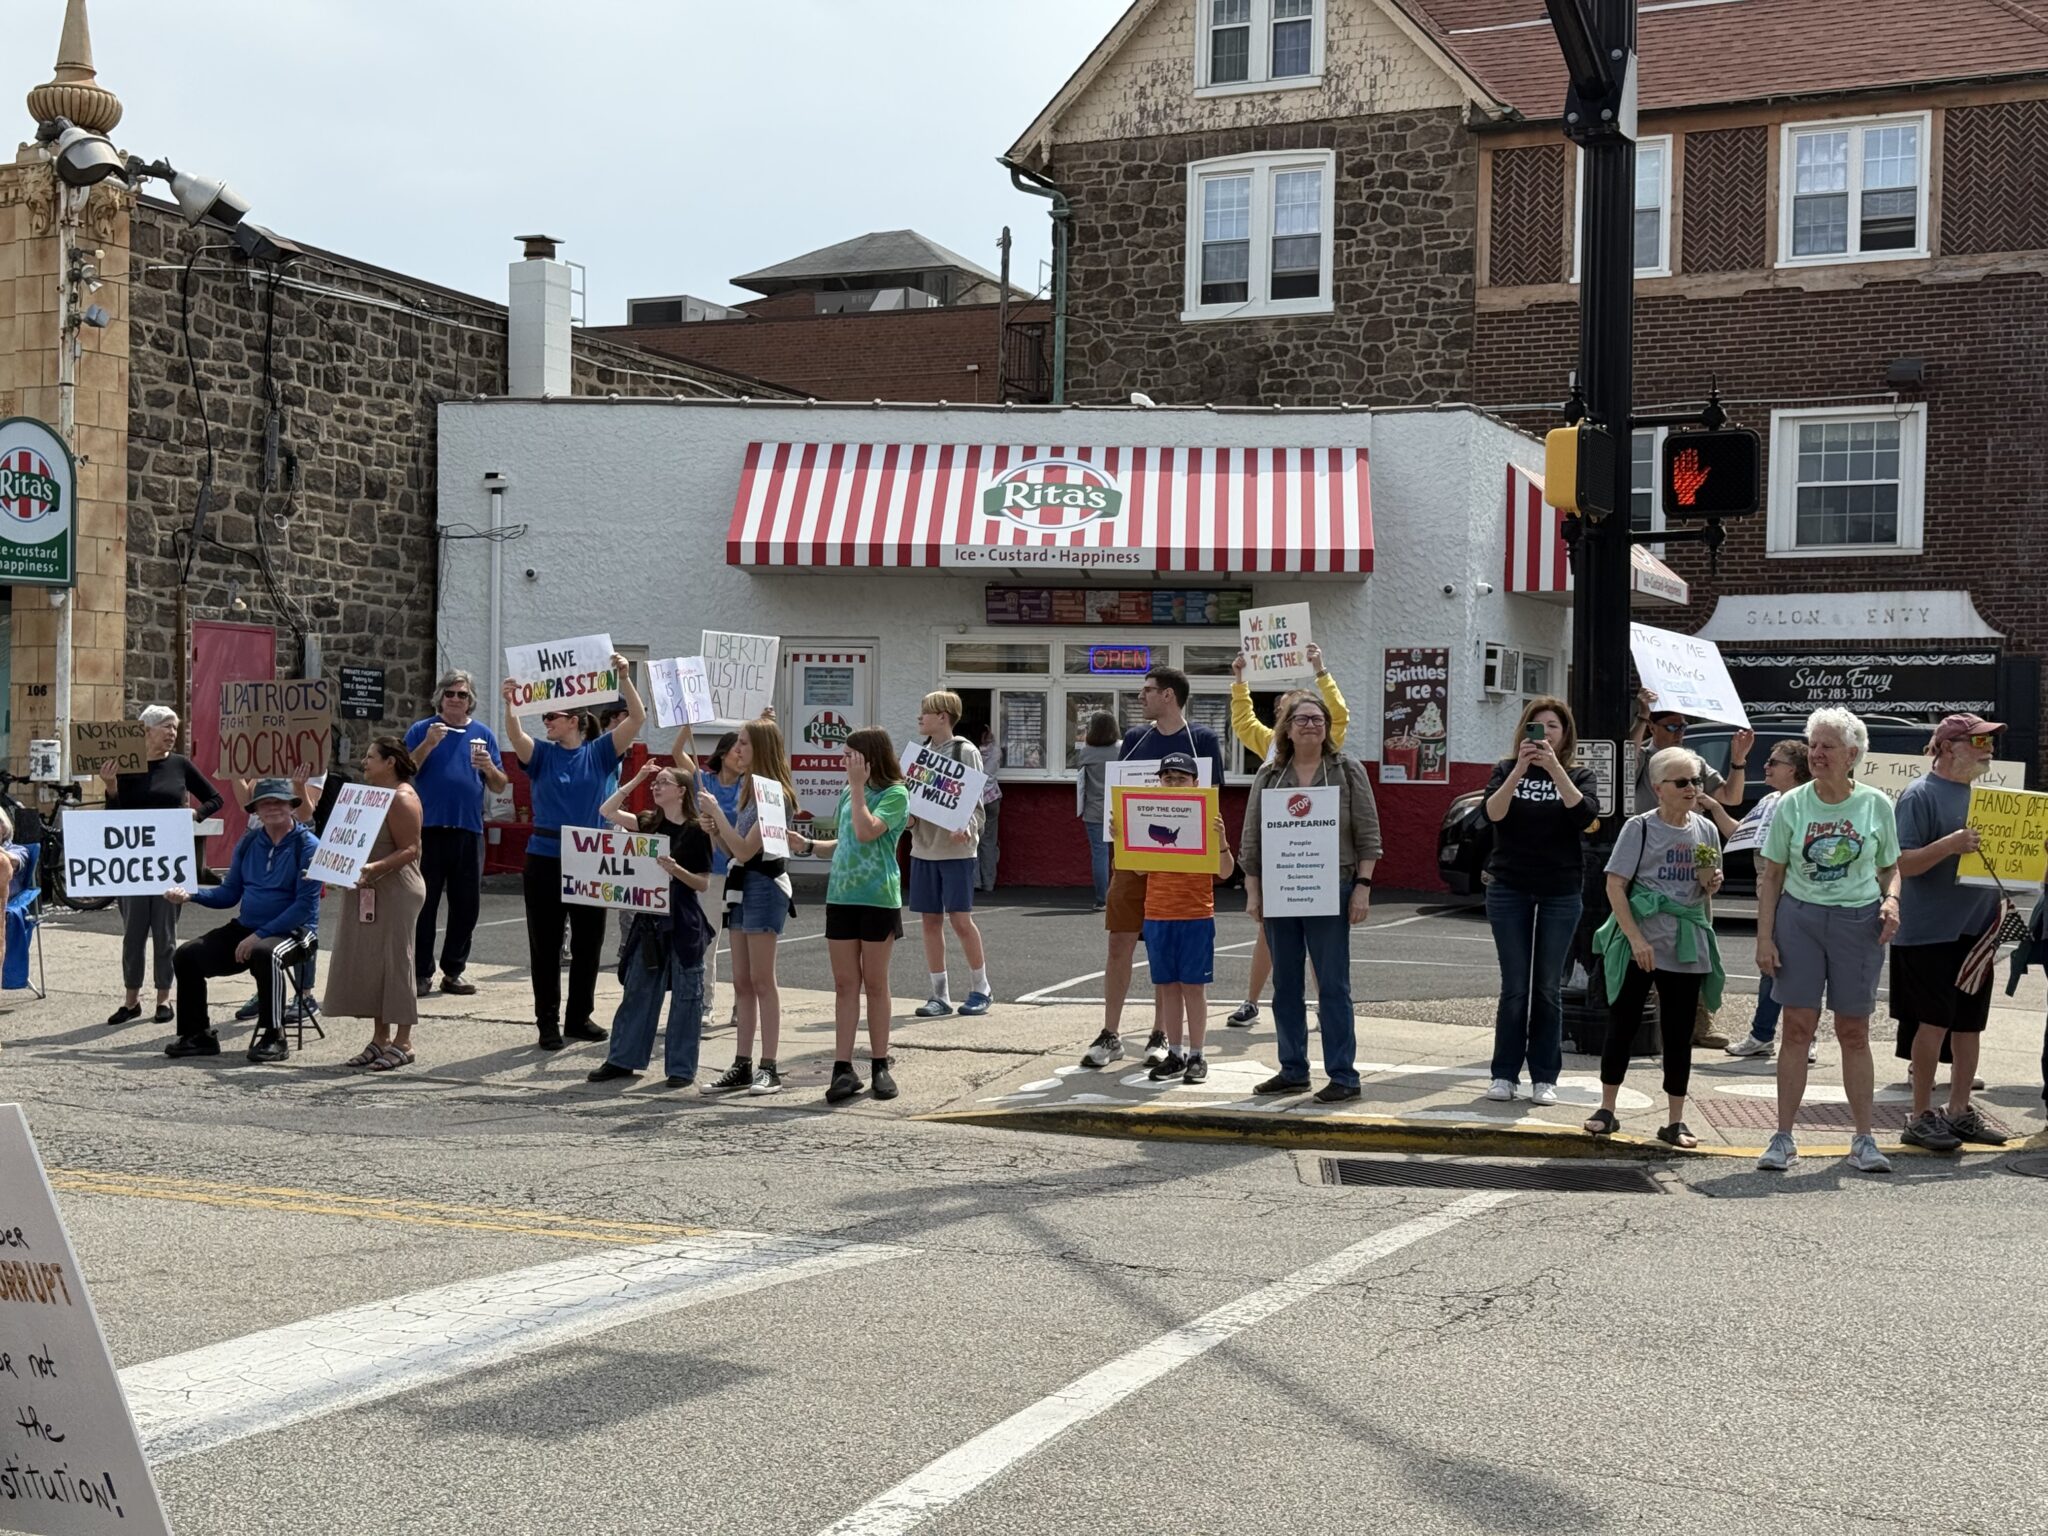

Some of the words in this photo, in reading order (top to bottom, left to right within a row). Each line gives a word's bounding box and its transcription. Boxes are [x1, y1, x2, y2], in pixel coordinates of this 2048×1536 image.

[0, 469, 54, 500] Rita's
[1003, 482, 1107, 511] Rita's
[15, 547, 58, 559] custard
[955, 548, 976, 561] Ice
[988, 548, 1048, 562] Custard
[1060, 549, 1140, 567] Happiness
[1267, 613, 1287, 631] ARE
[1746, 609, 1821, 626] SALON
[703, 631, 774, 664] LIBERTY
[1244, 632, 1298, 653] STRONGER
[1093, 650, 1148, 670] OPEN
[1251, 651, 1305, 672] TOGETHER
[1386, 664, 1447, 684] Skittles
[1789, 667, 1845, 689] Salon
[1846, 666, 1893, 693] Envy
[26, 685, 48, 697] 106
[234, 681, 328, 713] PATRIOTS
[511, 669, 619, 707] COMPASSION
[1807, 688, 1873, 700] 215-283-3173
[76, 723, 101, 741] NO
[105, 721, 146, 738] KINGS
[220, 716, 252, 730] FIGHT
[263, 715, 286, 728] FOR
[810, 720, 848, 739] Rita's
[98, 740, 117, 751] IN
[915, 748, 965, 779] BUILD
[1863, 760, 1880, 776] IF
[1888, 762, 1922, 778] THIS
[820, 778, 843, 786] Butler
[907, 763, 966, 796] KINDNESS
[1517, 778, 1557, 791] FIGH
[362, 789, 391, 809] ORDER
[921, 785, 960, 810] WALLS
[1289, 797, 1310, 815] STOP
[1973, 791, 2021, 815] HANDS
[344, 807, 363, 825] NOT
[1171, 806, 1192, 814] COUP!
[1267, 819, 1336, 829] DISAPPEARING
[1971, 816, 2017, 838] Personal
[2021, 820, 2043, 840] Data
[104, 825, 156, 850] DUE
[329, 827, 357, 846] CHAOS
[572, 830, 615, 855] WE
[622, 836, 660, 858] ARE
[1997, 840, 2006, 855] IS
[69, 855, 188, 887] PROCESS
[315, 848, 355, 875] DISORDER
[598, 856, 635, 876] ALL
[2004, 858, 2024, 874] USA
[1657, 866, 1698, 882] CHOIC
[562, 874, 669, 909] IMMIGRANTS
[16, 1405, 66, 1443] the
